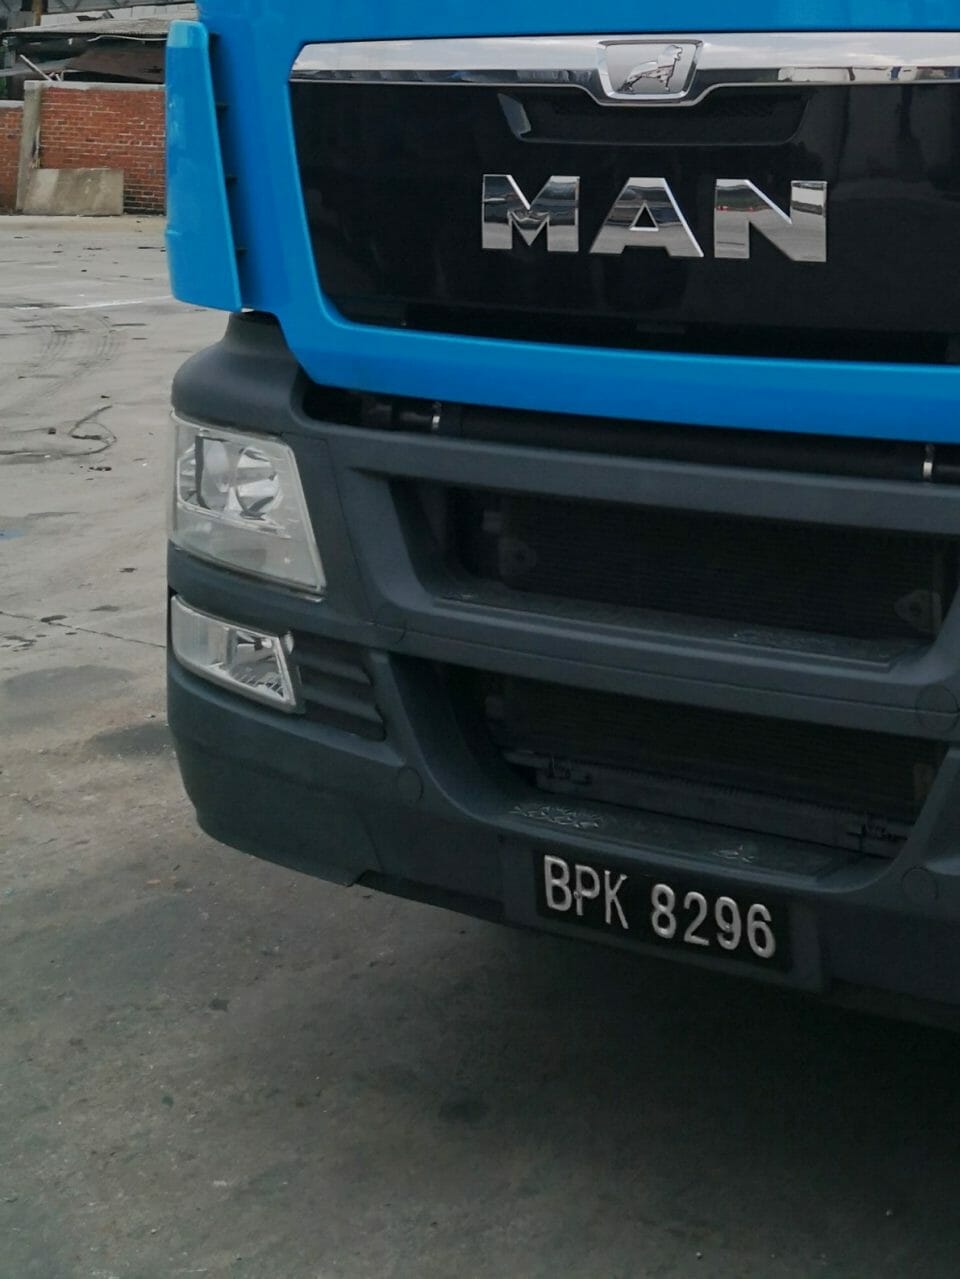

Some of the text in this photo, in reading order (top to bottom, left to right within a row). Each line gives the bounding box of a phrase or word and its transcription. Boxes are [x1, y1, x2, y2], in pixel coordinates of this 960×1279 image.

[481, 173, 828, 262] MAN
[543, 854, 776, 959] BPK 8296
